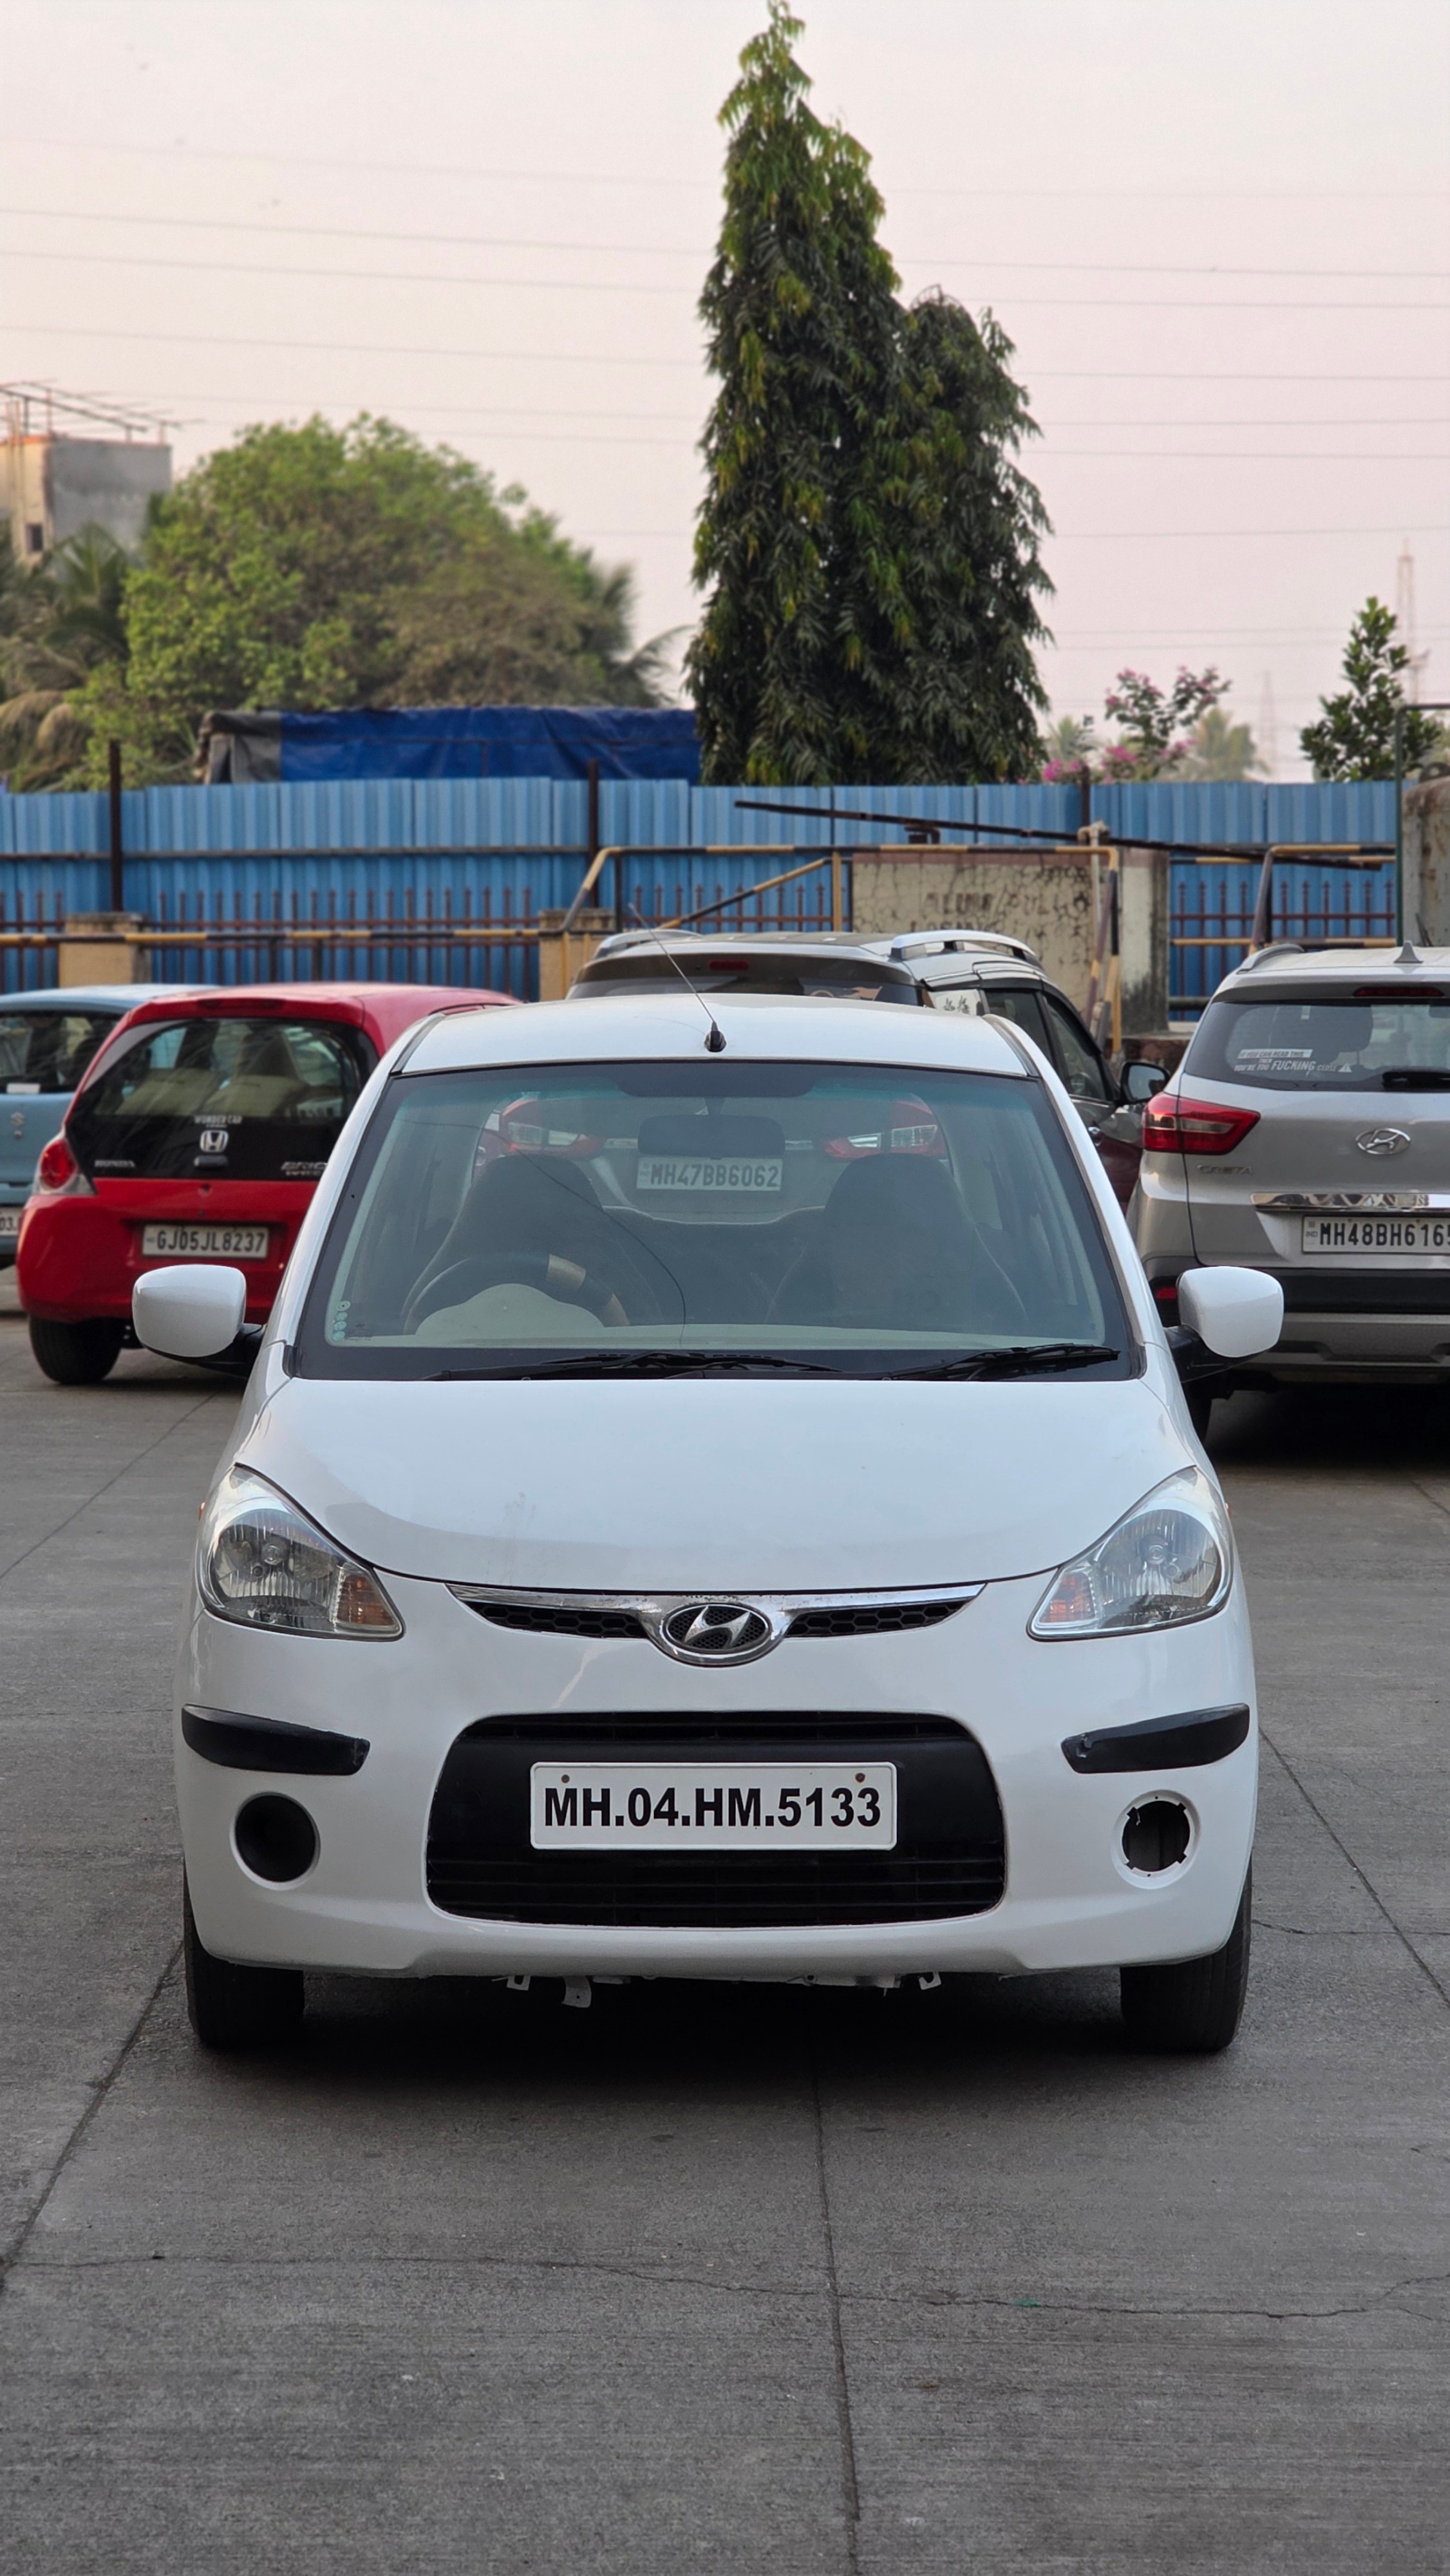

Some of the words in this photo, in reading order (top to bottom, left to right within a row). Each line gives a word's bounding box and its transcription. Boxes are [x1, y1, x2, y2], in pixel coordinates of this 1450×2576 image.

[1271, 1060, 1316, 1072] FUCKING
[650, 1163, 779, 1188] MH47BB6062
[157, 1230, 265, 1253] GJ05JL8237
[1320, 1222, 1450, 1247] MH48BH616
[544, 1787, 881, 1827] MH.04.HM.5133
